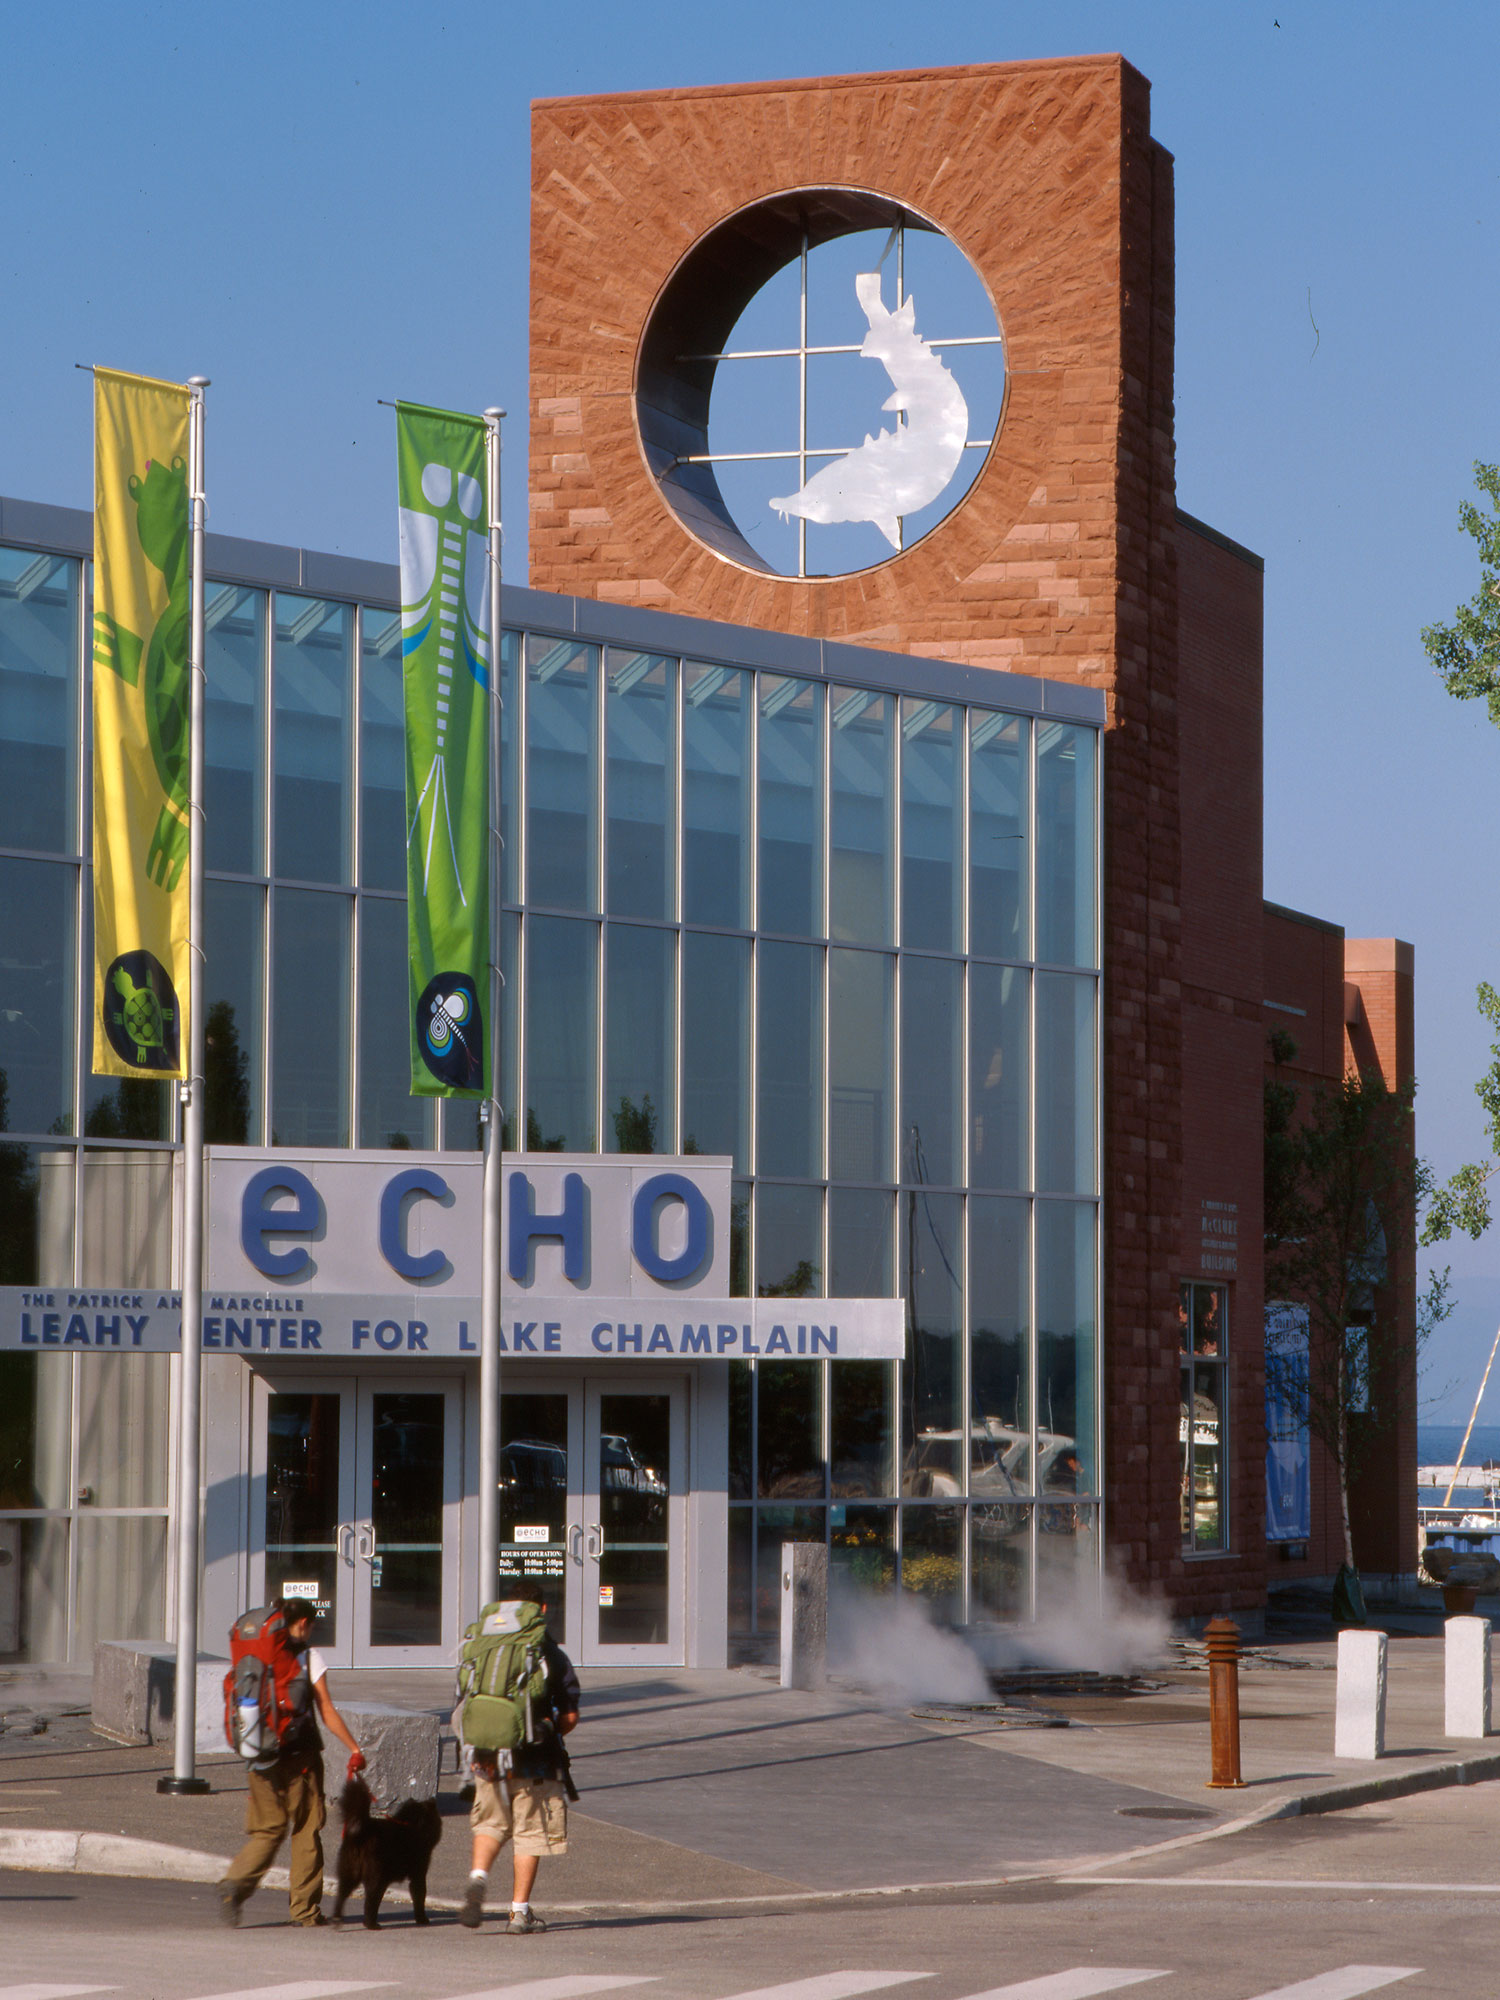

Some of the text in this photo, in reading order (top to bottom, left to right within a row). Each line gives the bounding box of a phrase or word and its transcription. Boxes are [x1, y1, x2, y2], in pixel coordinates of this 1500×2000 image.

[1201, 1254, 1237, 1272] BUILDING
[22, 1294, 304, 1312] THE PATRICK AN MARCELLE
[21, 1313, 150, 1345] LEAHY
[179, 1317, 322, 1349] ENTER
[352, 1319, 429, 1350] FOR
[591, 1323, 838, 1354] CHAMPLAIN
[499, 1559, 514, 1567] Daily:
[312, 1600, 331, 1608] PLEASE
